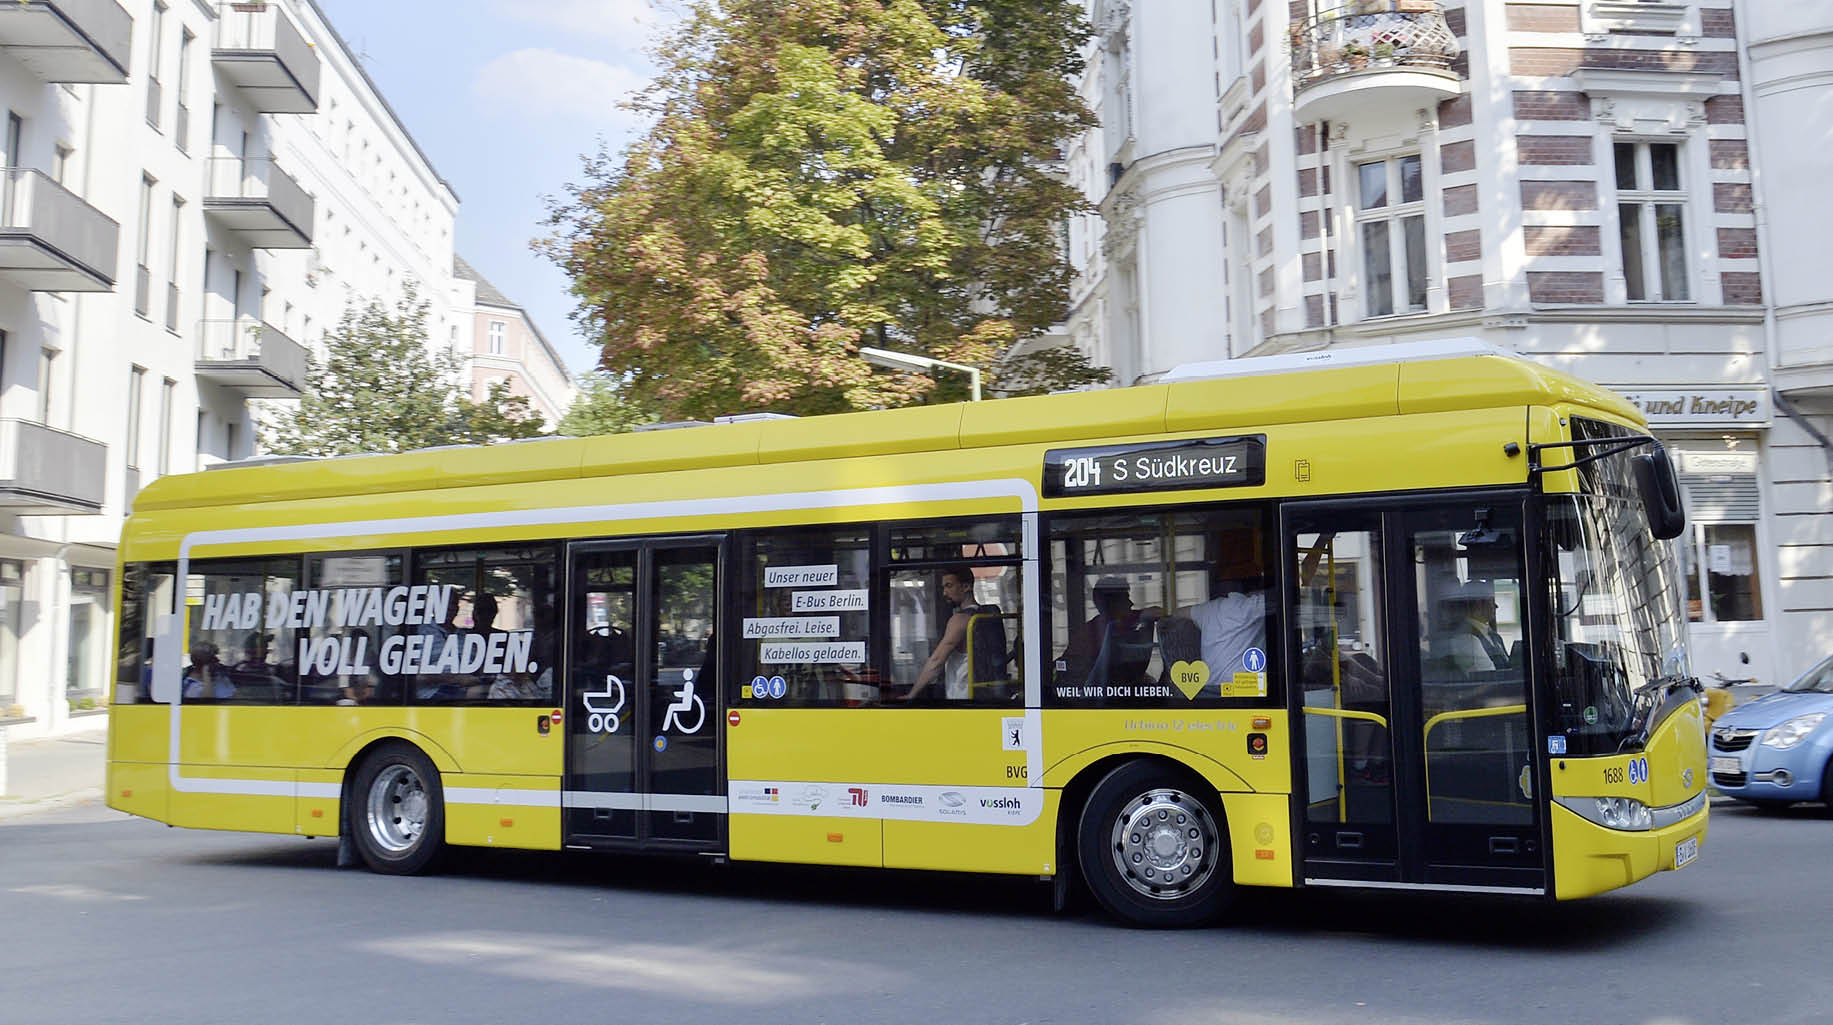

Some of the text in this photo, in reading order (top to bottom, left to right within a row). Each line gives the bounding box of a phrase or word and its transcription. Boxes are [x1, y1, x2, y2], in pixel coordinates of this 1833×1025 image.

[1645, 395, 1685, 415] und
[1690, 394, 1758, 419] Kneipe
[1064, 455, 1237, 488] 204 S Südkreuz
[768, 571, 835, 584] Unser neuer
[201, 584, 452, 631] HAB DEN WAGEN
[795, 593, 864, 608] E-Bus Berlin.
[746, 620, 836, 638] Abgasfrei. Leise.
[299, 631, 538, 677] VOLL GELADEN.
[764, 646, 861, 662] Kabellos geladen.
[1181, 672, 1200, 683] BVG
[1056, 685, 1174, 697] WEIL WIR DICH LIEBEN.
[1006, 765, 1028, 779] BVG
[1603, 767, 1624, 785] 1688
[881, 794, 923, 804] BOMBARDIER
[980, 797, 1021, 809] vossloh
